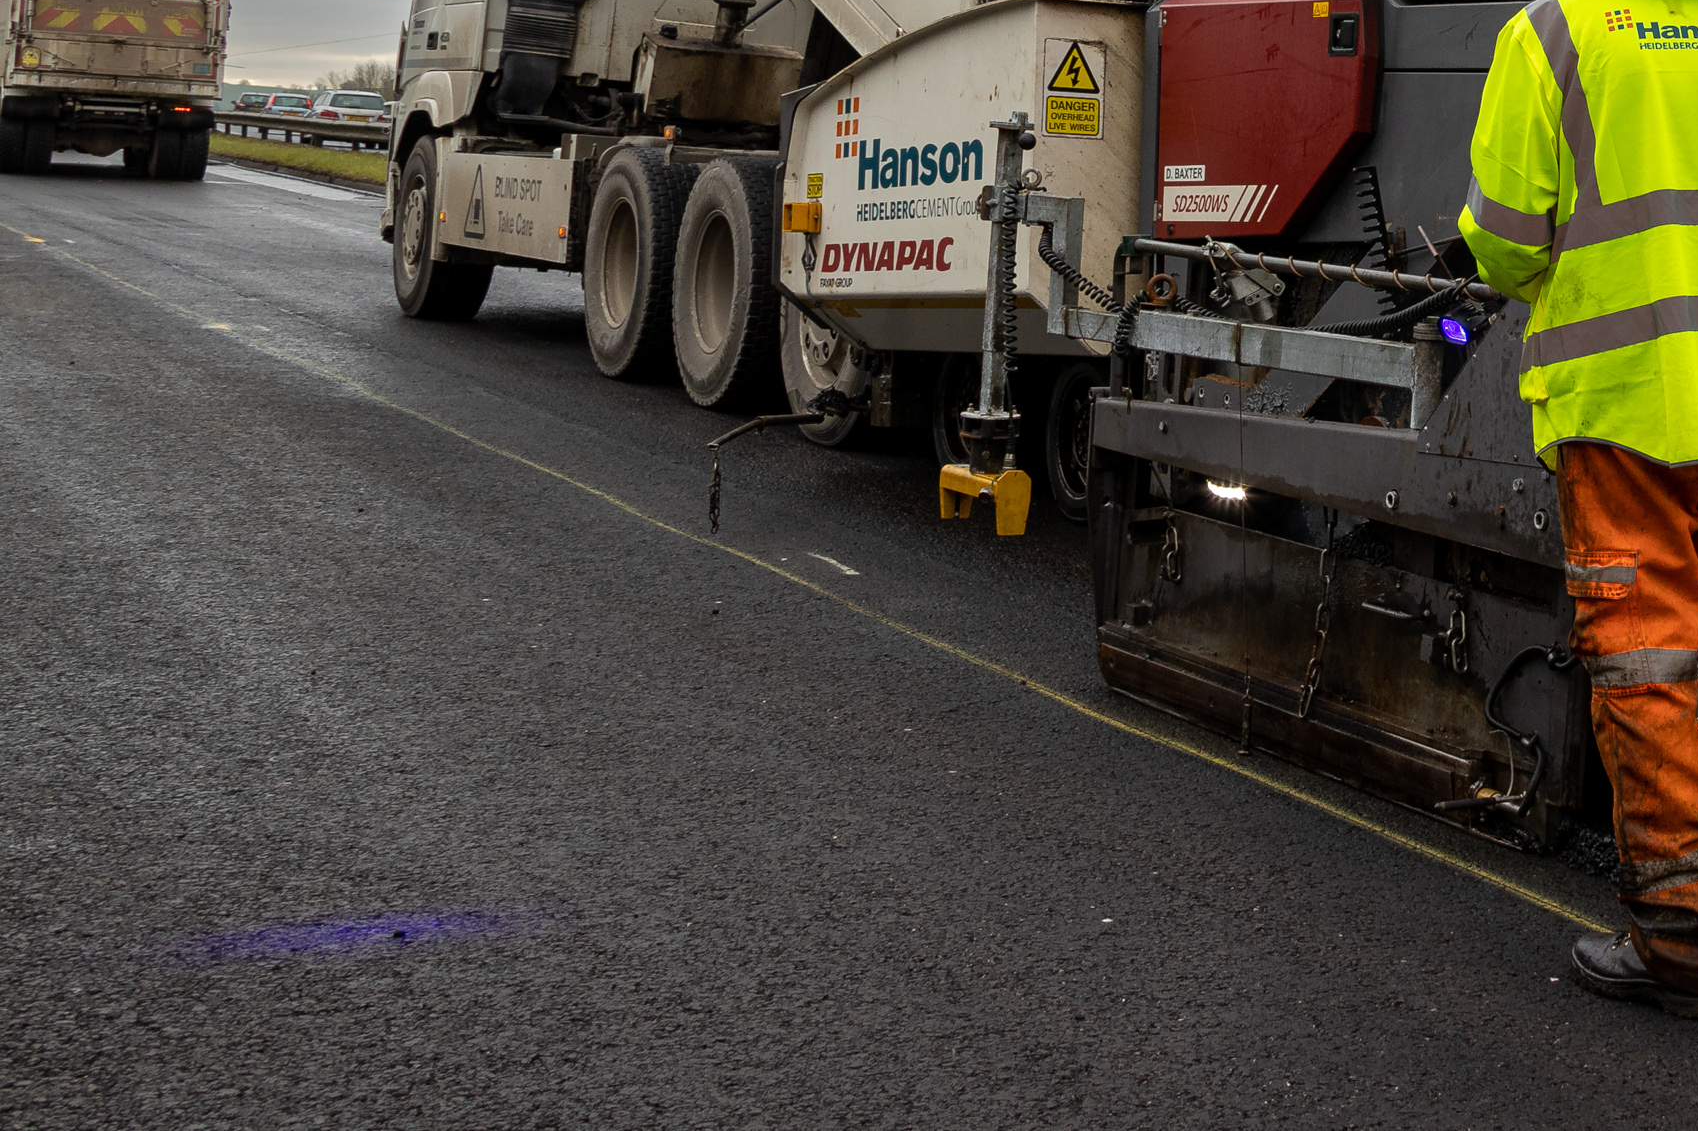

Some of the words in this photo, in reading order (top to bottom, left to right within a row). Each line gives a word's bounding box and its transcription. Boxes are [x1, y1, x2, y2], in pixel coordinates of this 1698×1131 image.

[1050, 100, 1096, 112] DANGER
[1050, 112, 1095, 122] OVERHEAD
[1049, 122, 1067, 130] LIVE
[1069, 123, 1096, 132] WIRES
[857, 138, 984, 191] Hanson
[1166, 168, 1174, 180] D.
[1175, 168, 1203, 179] BAXTER
[494, 176, 519, 199] BLIND
[520, 178, 543, 202] SPOT
[808, 184, 822, 196] STOP
[1172, 194, 1230, 213] SD2500WS
[497, 210, 515, 234] Take
[515, 212, 534, 237] Care
[821, 236, 955, 273] DYNAPAC
